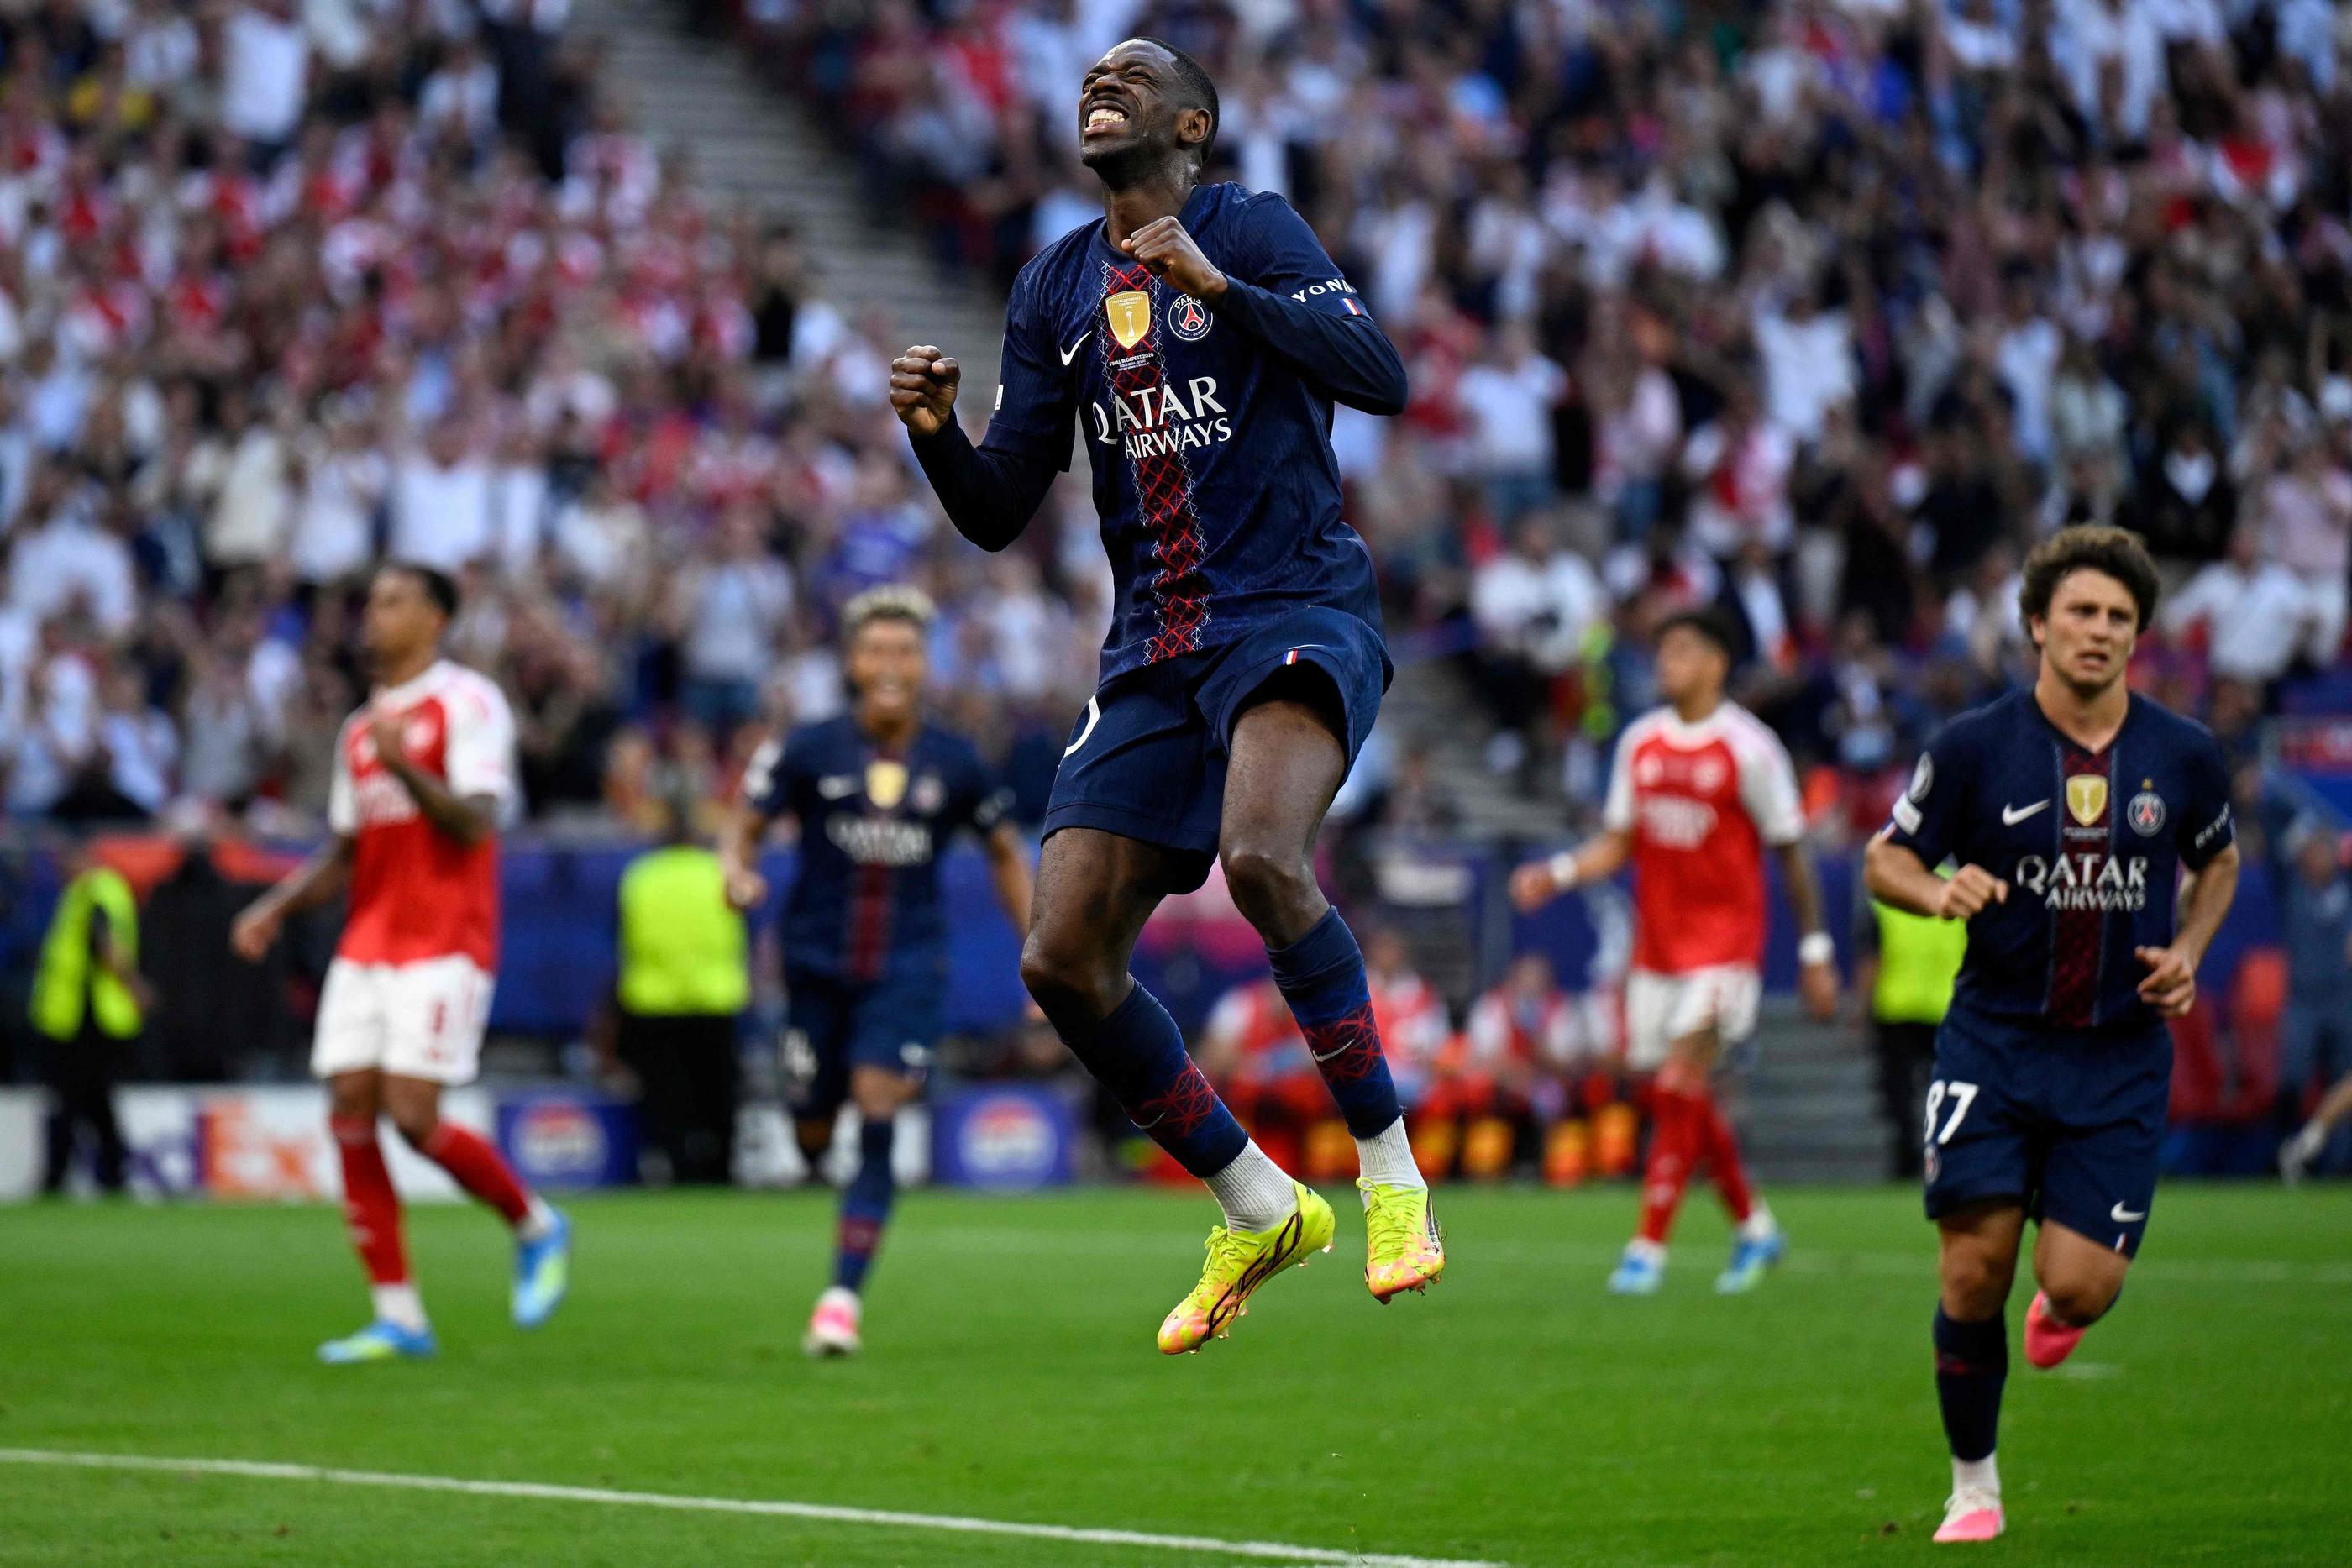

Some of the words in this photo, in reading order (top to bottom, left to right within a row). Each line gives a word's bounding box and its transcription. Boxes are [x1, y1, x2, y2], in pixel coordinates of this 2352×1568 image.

[1092, 376, 1227, 445] QATAR
[1125, 417, 1231, 459] AIRWAYS
[2016, 852, 2148, 895] QATAR
[2045, 886, 2146, 911] AIRWAYS
